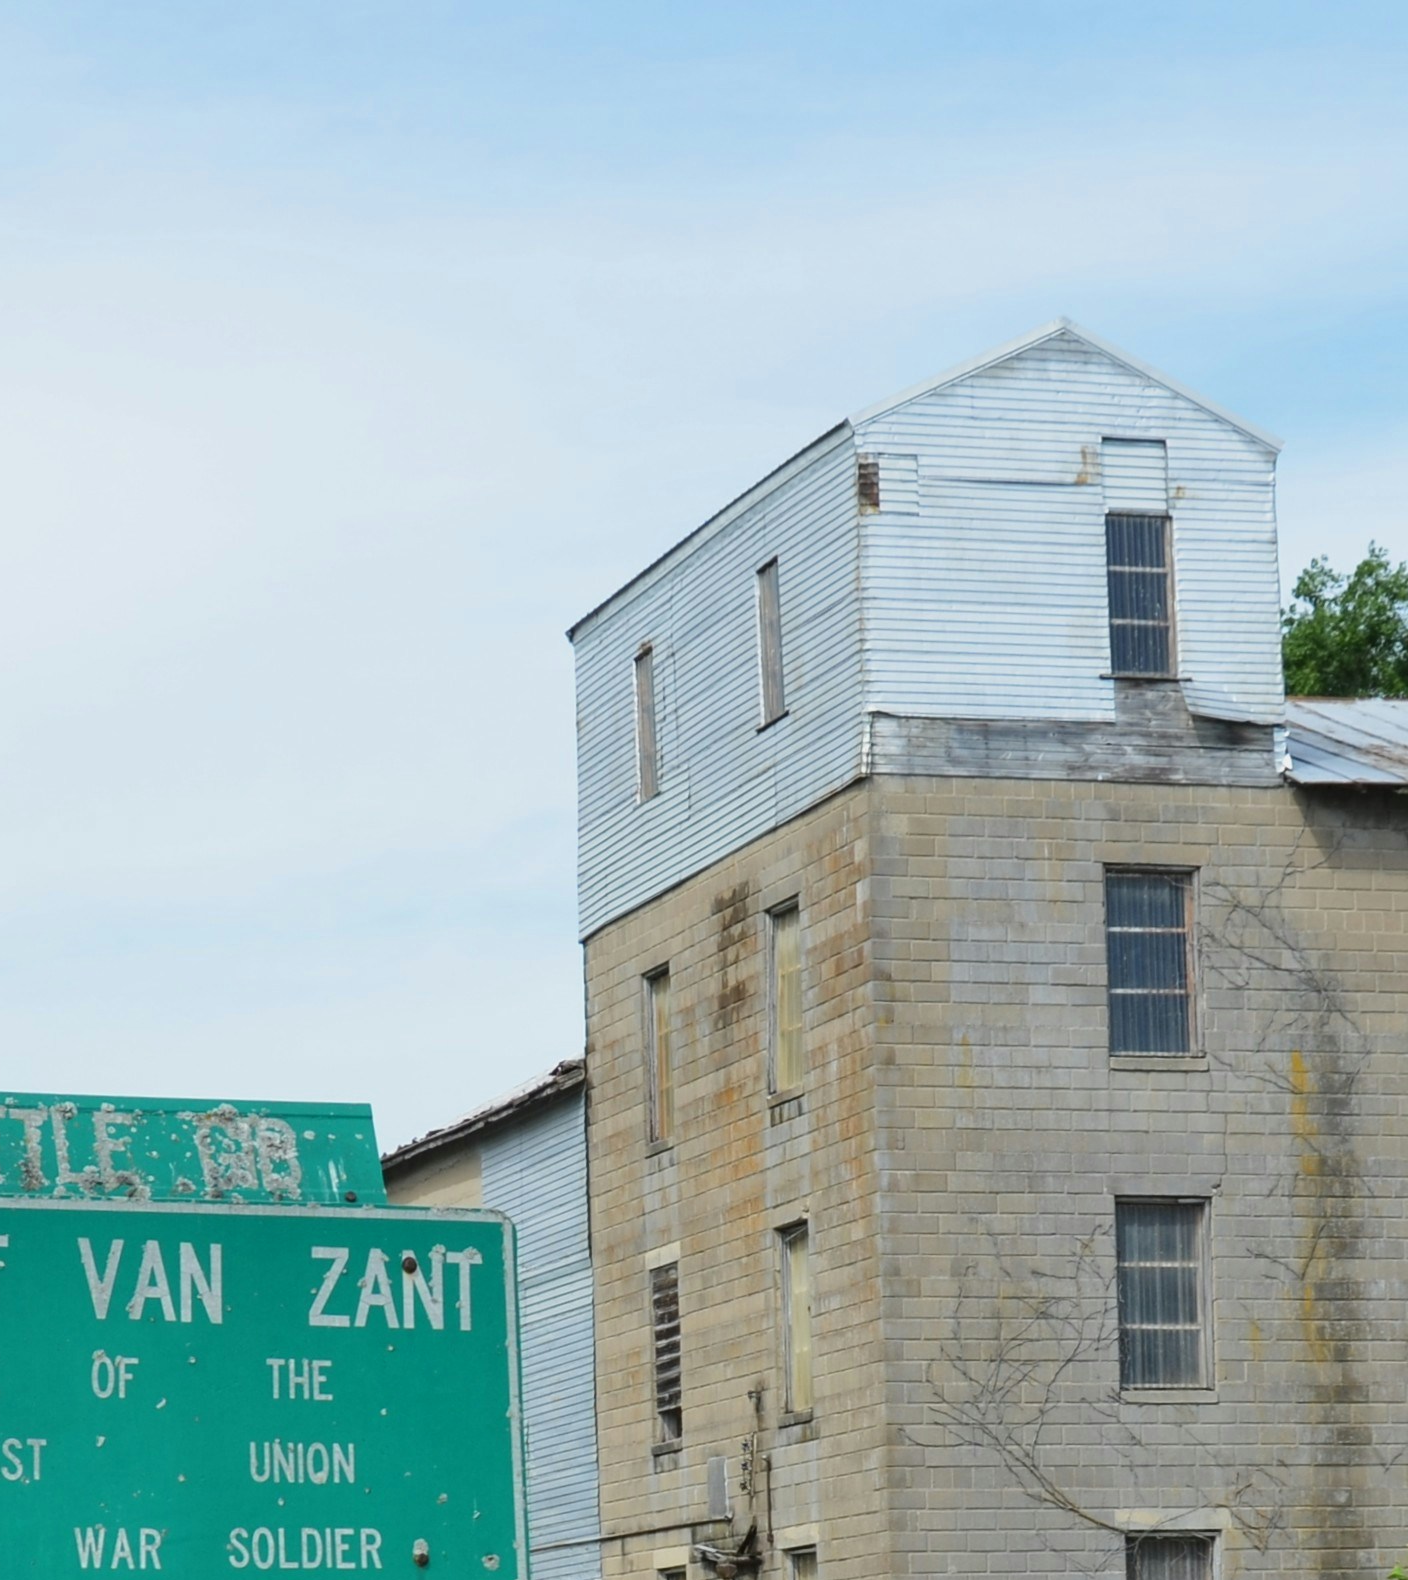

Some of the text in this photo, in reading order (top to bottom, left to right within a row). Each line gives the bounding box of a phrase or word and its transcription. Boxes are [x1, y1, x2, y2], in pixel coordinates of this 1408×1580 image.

[78, 1237, 222, 1324] VAN
[309, 1244, 482, 1331] ZANT
[91, 1354, 139, 1399] OF
[267, 1358, 333, 1401] THE
[249, 1441, 355, 1483] UNION
[75, 1528, 162, 1570] WAR
[229, 1527, 382, 1570] SOLDIER
